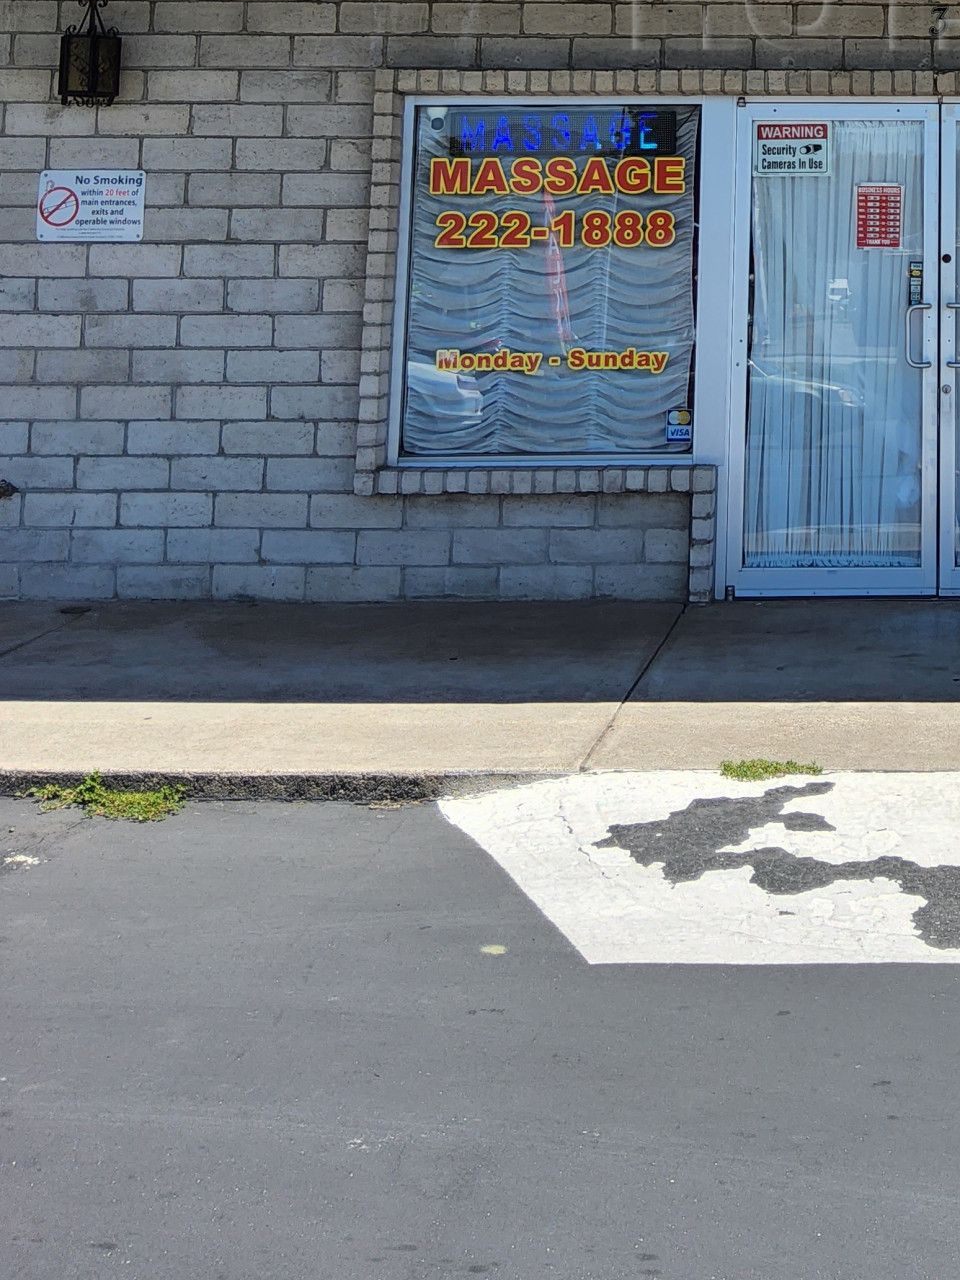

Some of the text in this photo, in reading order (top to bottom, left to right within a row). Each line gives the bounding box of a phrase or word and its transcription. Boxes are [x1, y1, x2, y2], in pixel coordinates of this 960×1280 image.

[460, 112, 657, 151] MASSAGE
[760, 126, 824, 138] WARNING
[762, 144, 797, 157] Security
[761, 158, 823, 169] Cameras In Use
[75, 175, 143, 187] No Smoking
[429, 156, 686, 196] MASSAGE
[131, 188, 139, 196] of
[110, 208, 124, 216] and
[75, 218, 107, 226] operable
[435, 210, 676, 249] 222-1888
[436, 348, 543, 373] Monday
[567, 347, 669, 374] Sunday
[670, 428, 690, 437] VISA
